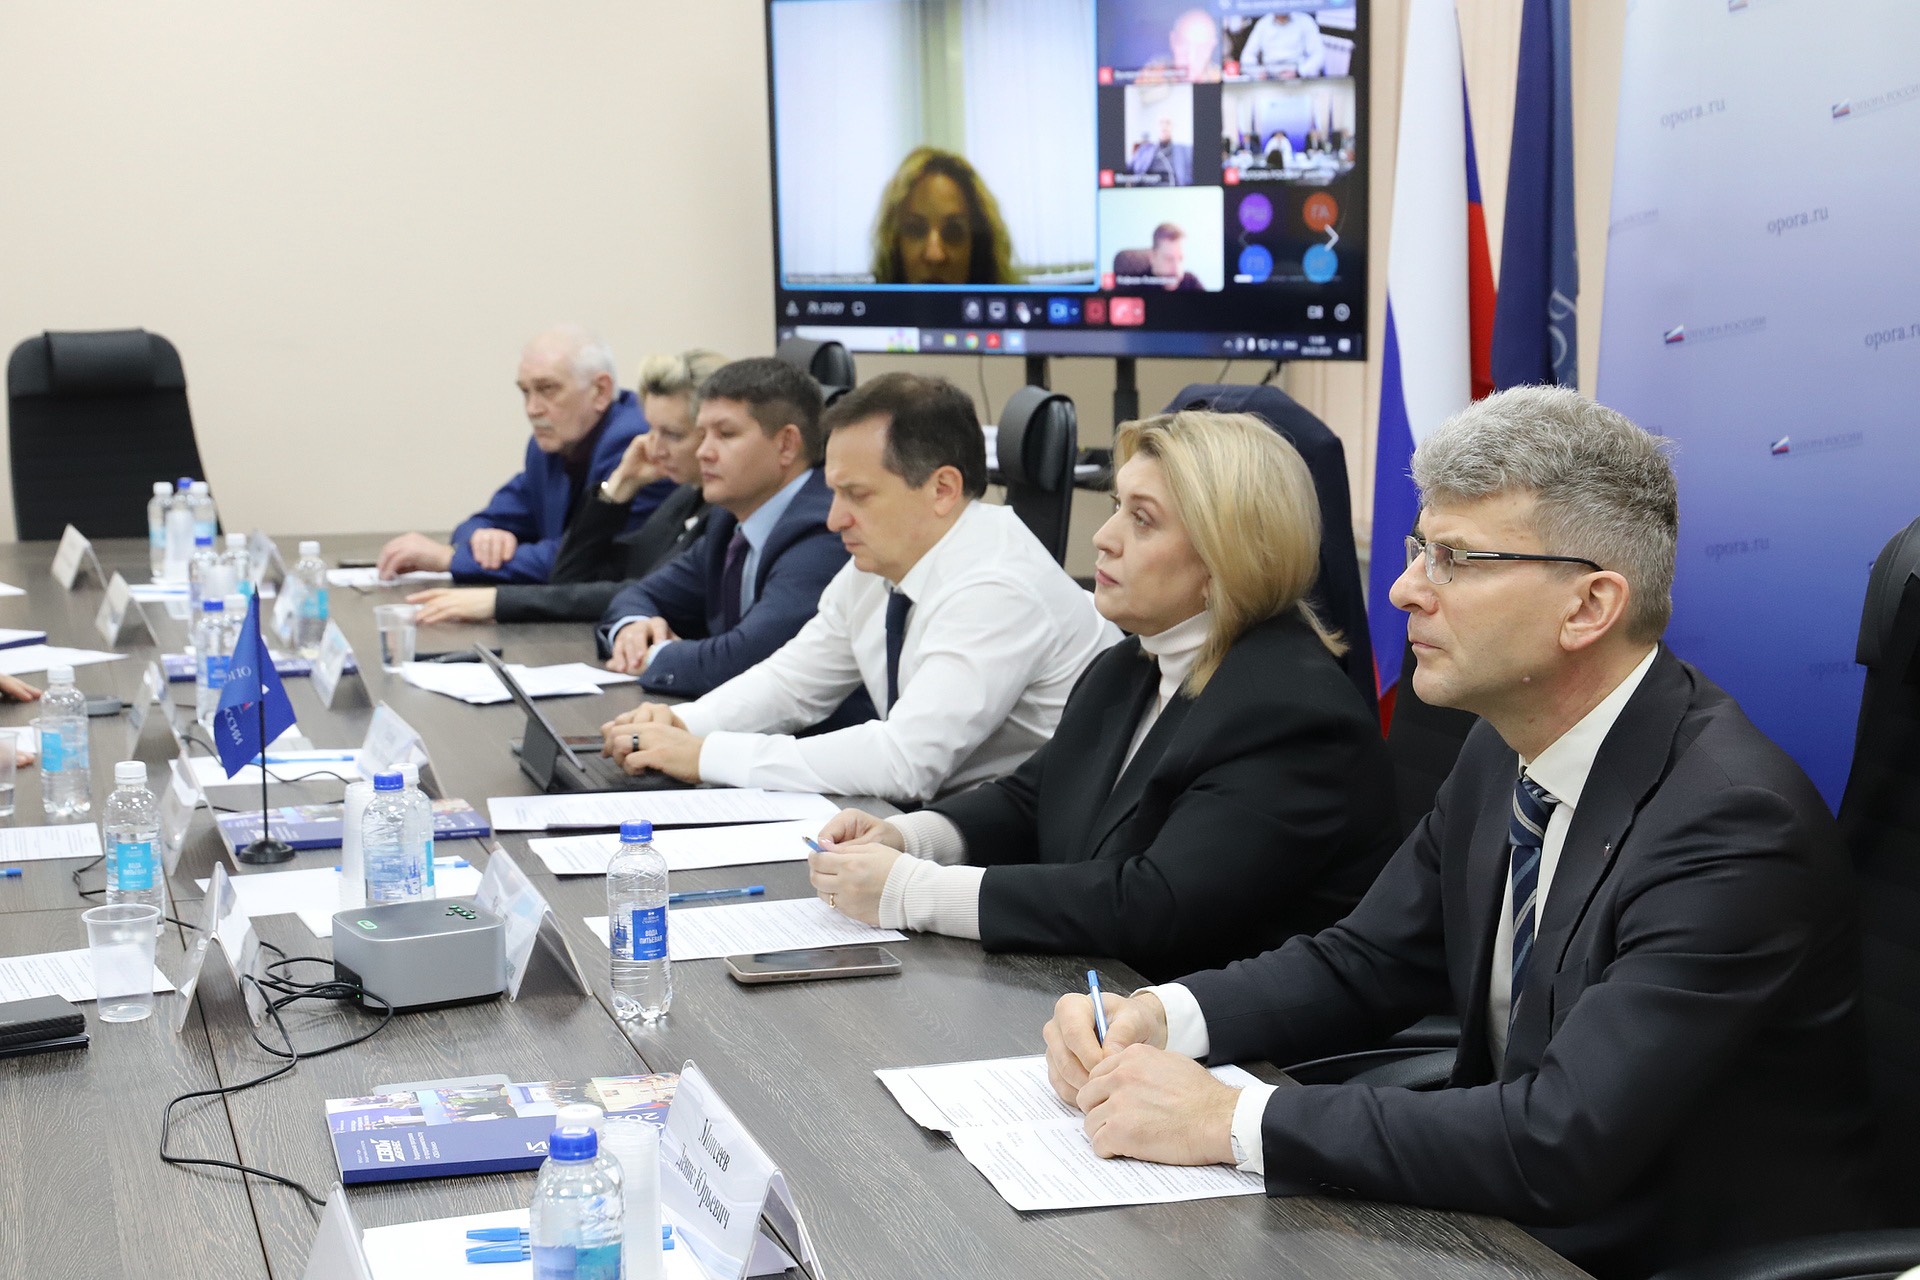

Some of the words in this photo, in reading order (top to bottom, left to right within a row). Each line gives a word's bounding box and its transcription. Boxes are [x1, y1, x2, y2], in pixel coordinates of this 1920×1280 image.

[1660, 98, 1726, 130] opora.ru
[1767, 206, 1830, 236] opora.ru
[1704, 537, 1770, 563] opora.ru
[698, 1118, 731, 1173] Моисеев
[693, 1166, 731, 1230] Юрьевич
